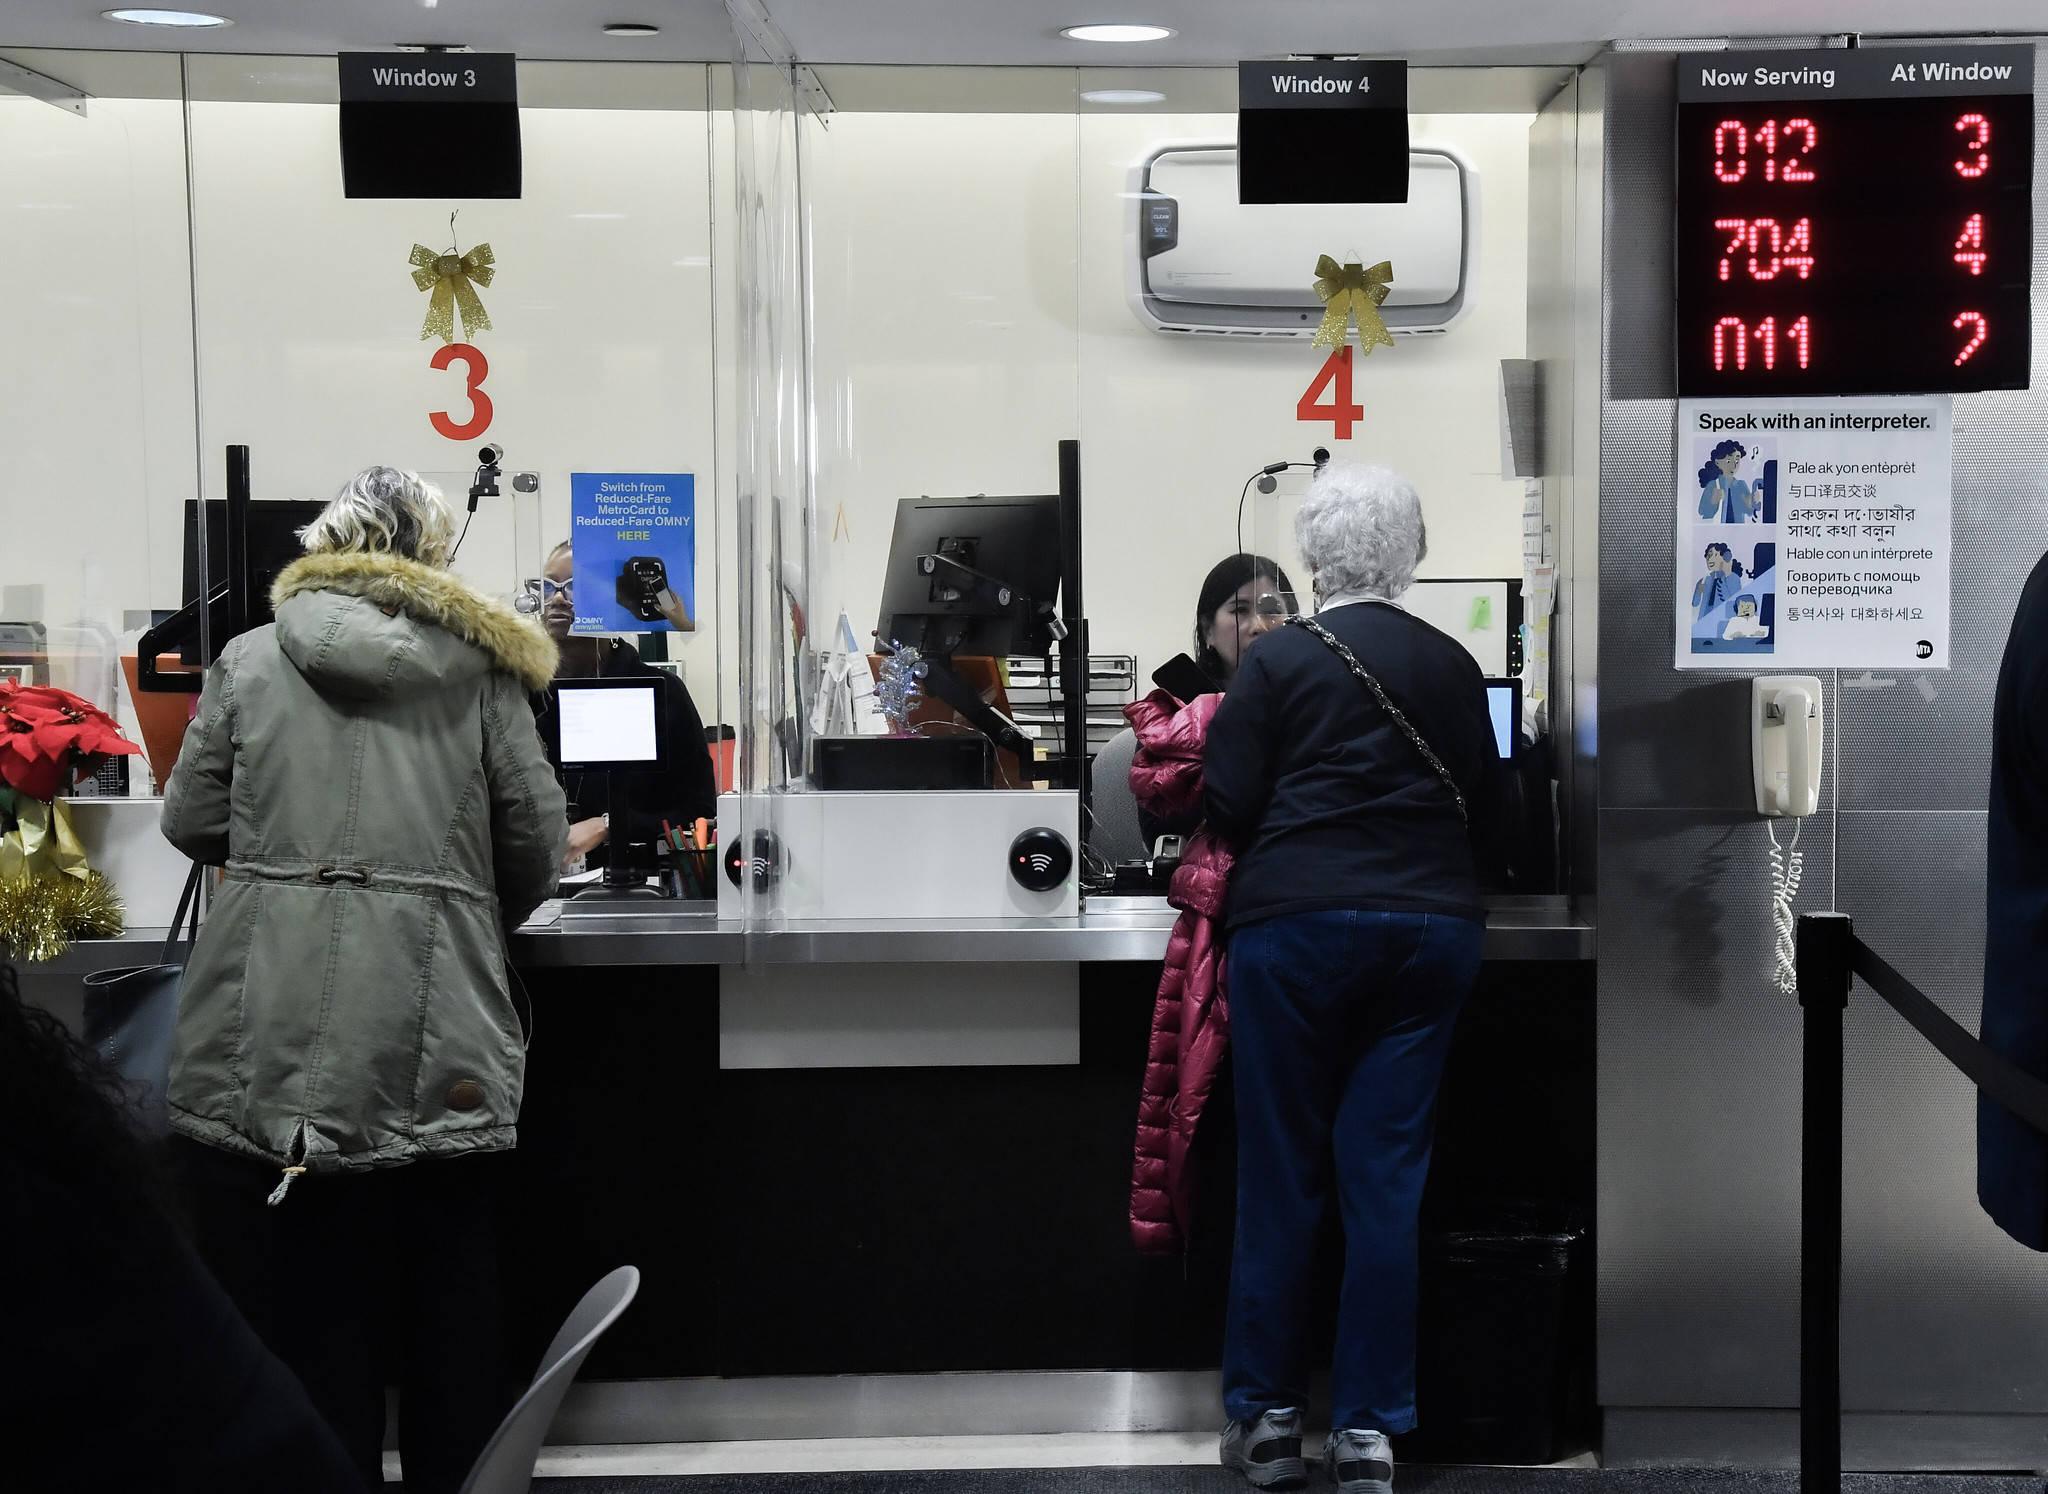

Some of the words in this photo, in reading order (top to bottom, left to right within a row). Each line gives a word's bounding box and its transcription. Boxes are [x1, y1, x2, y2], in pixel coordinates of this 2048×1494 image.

[373, 69, 457, 86] Window
[465, 70, 475, 86] 3
[1702, 69, 1747, 86] Now
[1755, 67, 1834, 87] Serving
[1891, 64, 1915, 81] At
[1922, 63, 2012, 80] Window
[1272, 76, 1352, 93] Window
[1359, 77, 1369, 92] 4
[1715, 119, 1816, 182] 012
[1955, 114, 1990, 177] 3
[1715, 218, 1814, 281] 704
[1954, 214, 1987, 275] 4
[429, 343, 493, 441] 3
[1297, 345, 1364, 440] 4
[1698, 414, 1758, 432] Speak
[1761, 413, 1800, 428] with
[1803, 417, 1826, 428] an
[1829, 413, 1931, 431] interpreter.
[1788, 462, 1816, 473] Pale
[1818, 462, 1834, 473] ak
[1835, 465, 1859, 475] yon
[1861, 462, 1916, 475] entèprèt
[600, 482, 638, 492] Switch
[639, 483, 666, 493] from
[1788, 484, 1877, 498] 与口译员交谈
[595, 494, 672, 504] Reduced-Fare
[598, 505, 656, 515] MetroCard
[657, 506, 669, 515] to
[1788, 509, 1839, 520] একজন
[576, 516, 653, 526] Reduced-Fare
[654, 517, 691, 526] OMNY
[617, 531, 651, 541] HERE
[1825, 526, 1858, 537] কথা
[1861, 526, 1896, 541] বলুন
[1787, 548, 1824, 559] Hable
[1826, 551, 1851, 559] con
[1852, 551, 1869, 559] un
[1870, 548, 1933, 561] intérprete
[1787, 570, 1851, 584] Говорить
[1853, 573, 1861, 581] с
[1863, 573, 1921, 583] помощь
[1787, 586, 1798, 594] ю
[1801, 586, 1893, 597] переводчика
[1787, 608, 1845, 621] 통역사와
[1851, 608, 1923, 620] 대화하세요
